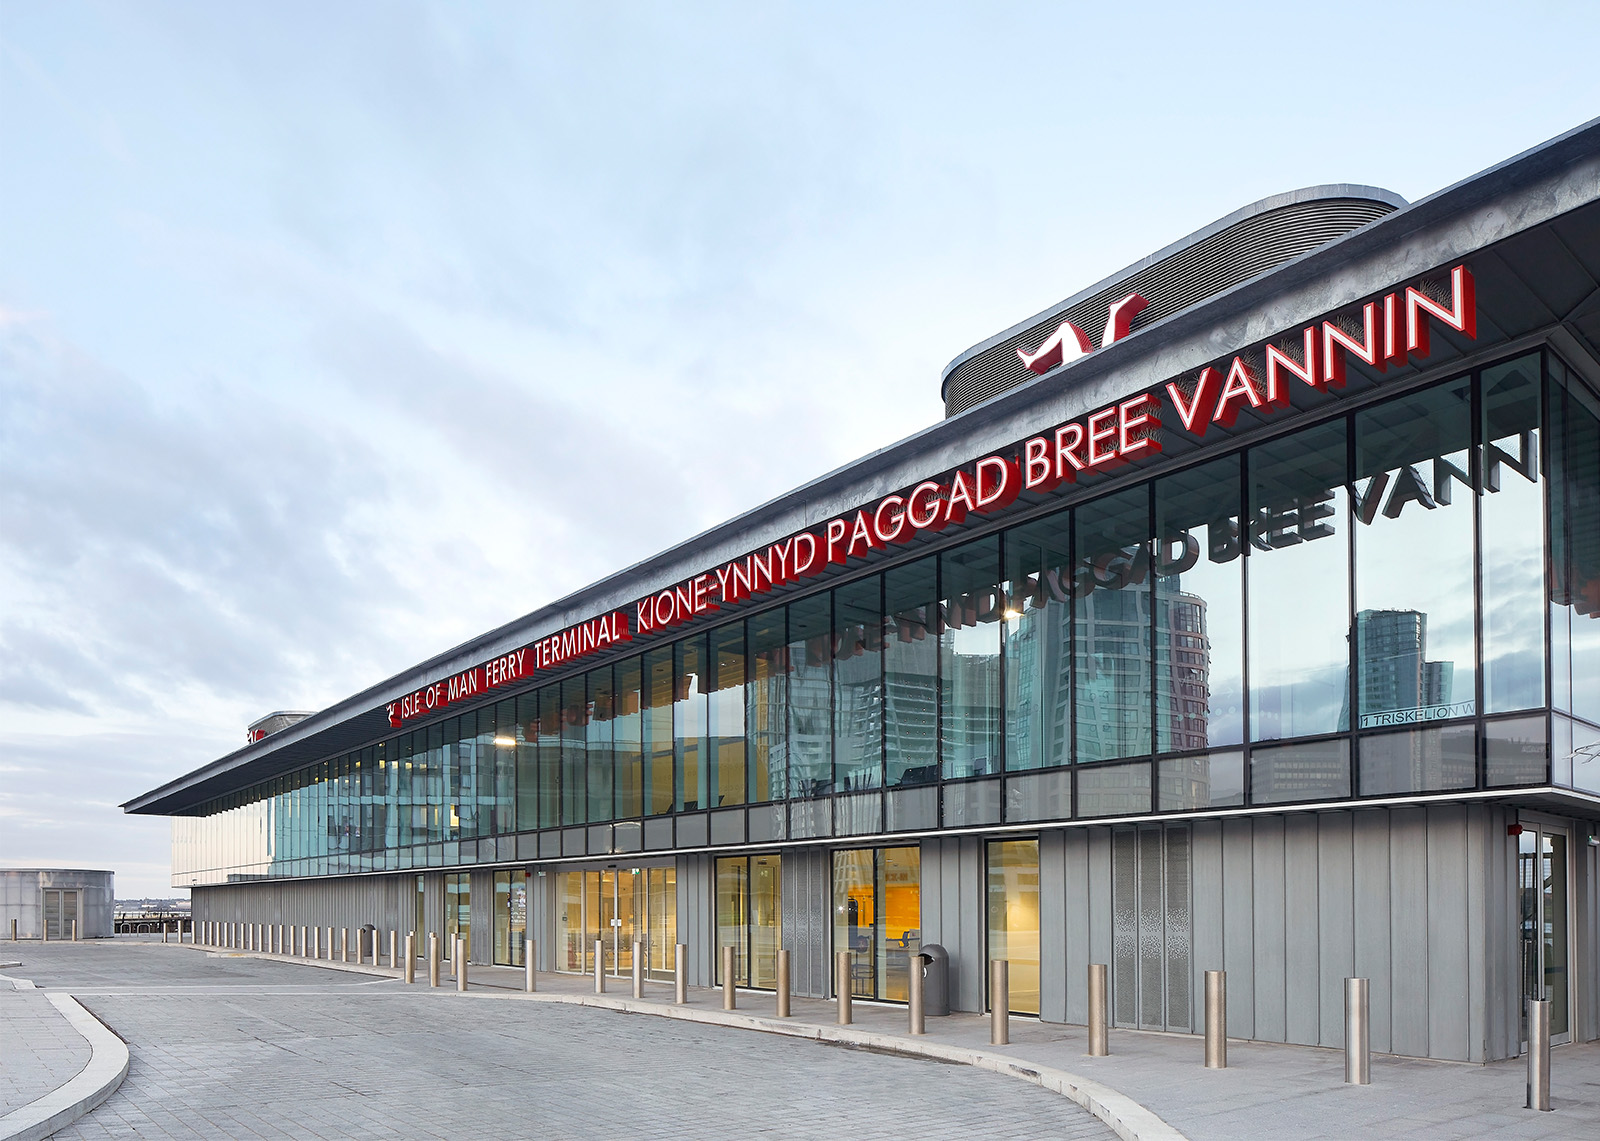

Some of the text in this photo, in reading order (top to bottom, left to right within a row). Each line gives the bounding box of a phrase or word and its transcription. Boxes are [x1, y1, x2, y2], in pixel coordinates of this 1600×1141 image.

[400, 694, 421, 719] ISLE
[426, 683, 442, 708] OF
[447, 668, 478, 702] MAN
[485, 648, 528, 689] FERRY
[534, 612, 620, 669] TERMINAL
[636, 532, 817, 633] KIONE-YNNYD
[827, 455, 1009, 563] PAGGAD
[1024, 393, 1149, 490] BREE
[1166, 264, 1465, 432] VANNIN
[1363, 716, 1369, 726] 1
[1374, 705, 1459, 725] TRISKELION
